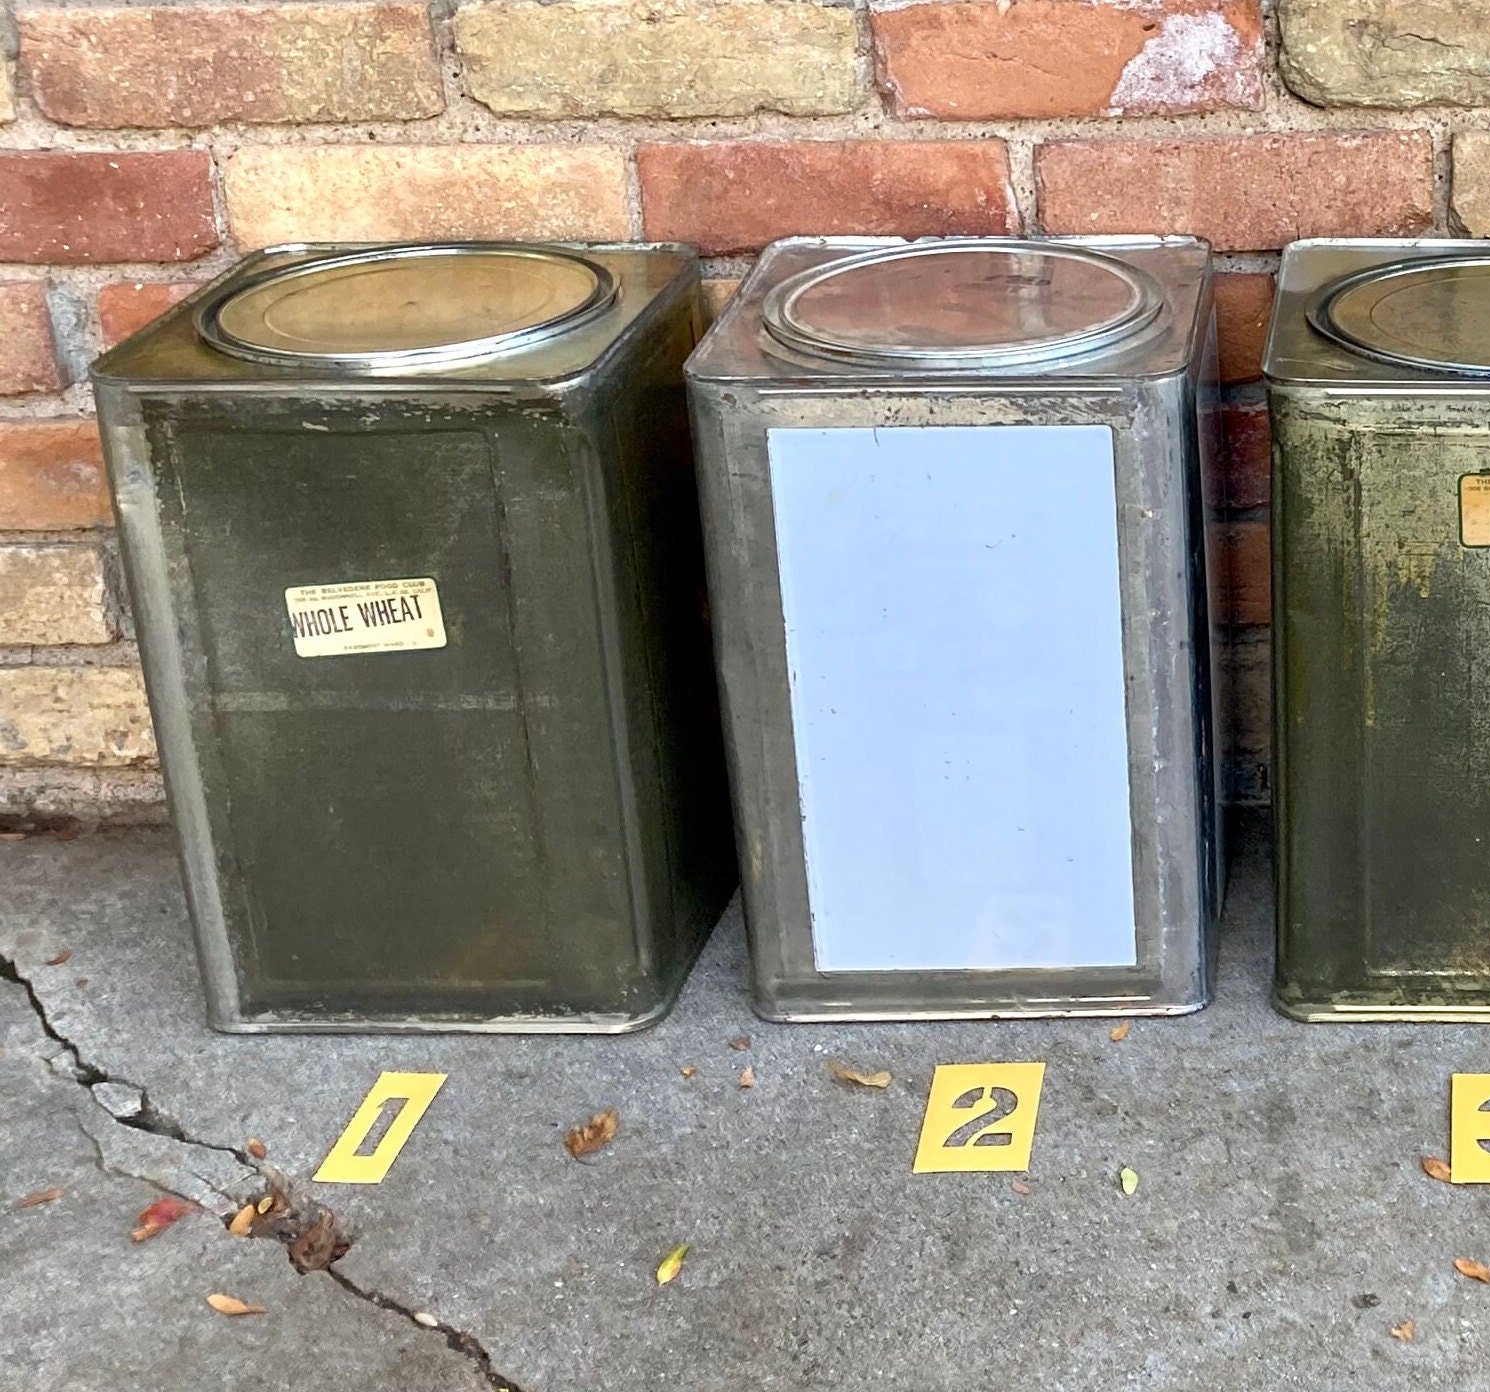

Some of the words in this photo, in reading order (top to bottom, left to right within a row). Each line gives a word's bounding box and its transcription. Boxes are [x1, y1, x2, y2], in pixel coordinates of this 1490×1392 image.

[300, 588, 316, 596] THE
[321, 584, 371, 595] BELVEDERE
[375, 582, 399, 590] FOOD
[292, 605, 353, 639] WHOLE
[357, 594, 422, 629] WHEAT
[352, 1097, 410, 1157] 1
[943, 1086, 1018, 1147] 2
